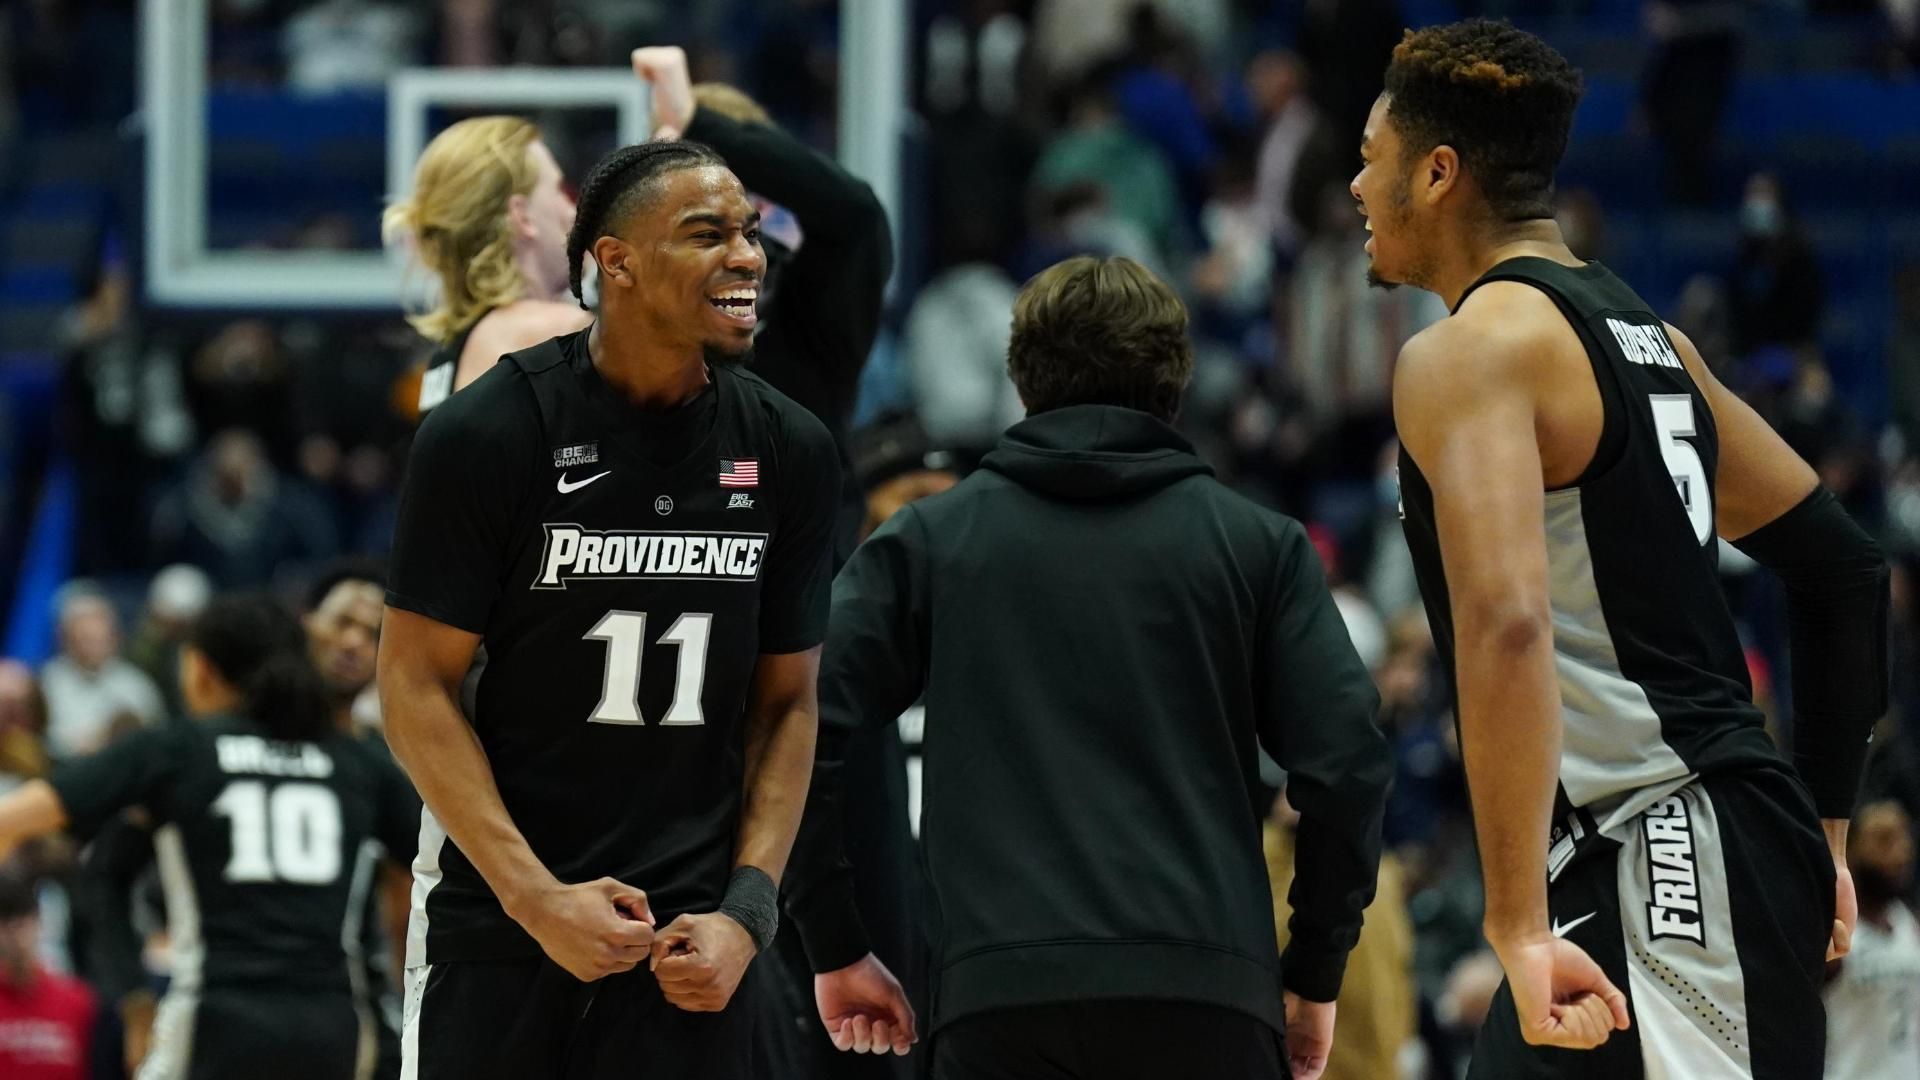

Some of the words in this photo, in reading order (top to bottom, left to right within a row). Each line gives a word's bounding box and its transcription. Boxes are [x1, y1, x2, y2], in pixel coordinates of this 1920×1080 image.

[554, 455, 598, 468] CHANGE
[728, 499, 755, 507] EAST
[1648, 393, 1712, 547] 5
[541, 528, 764, 584] PROVIDENCE
[581, 609, 713, 726] 11
[209, 779, 342, 884] 10
[1645, 796, 1702, 942] FRIARS
